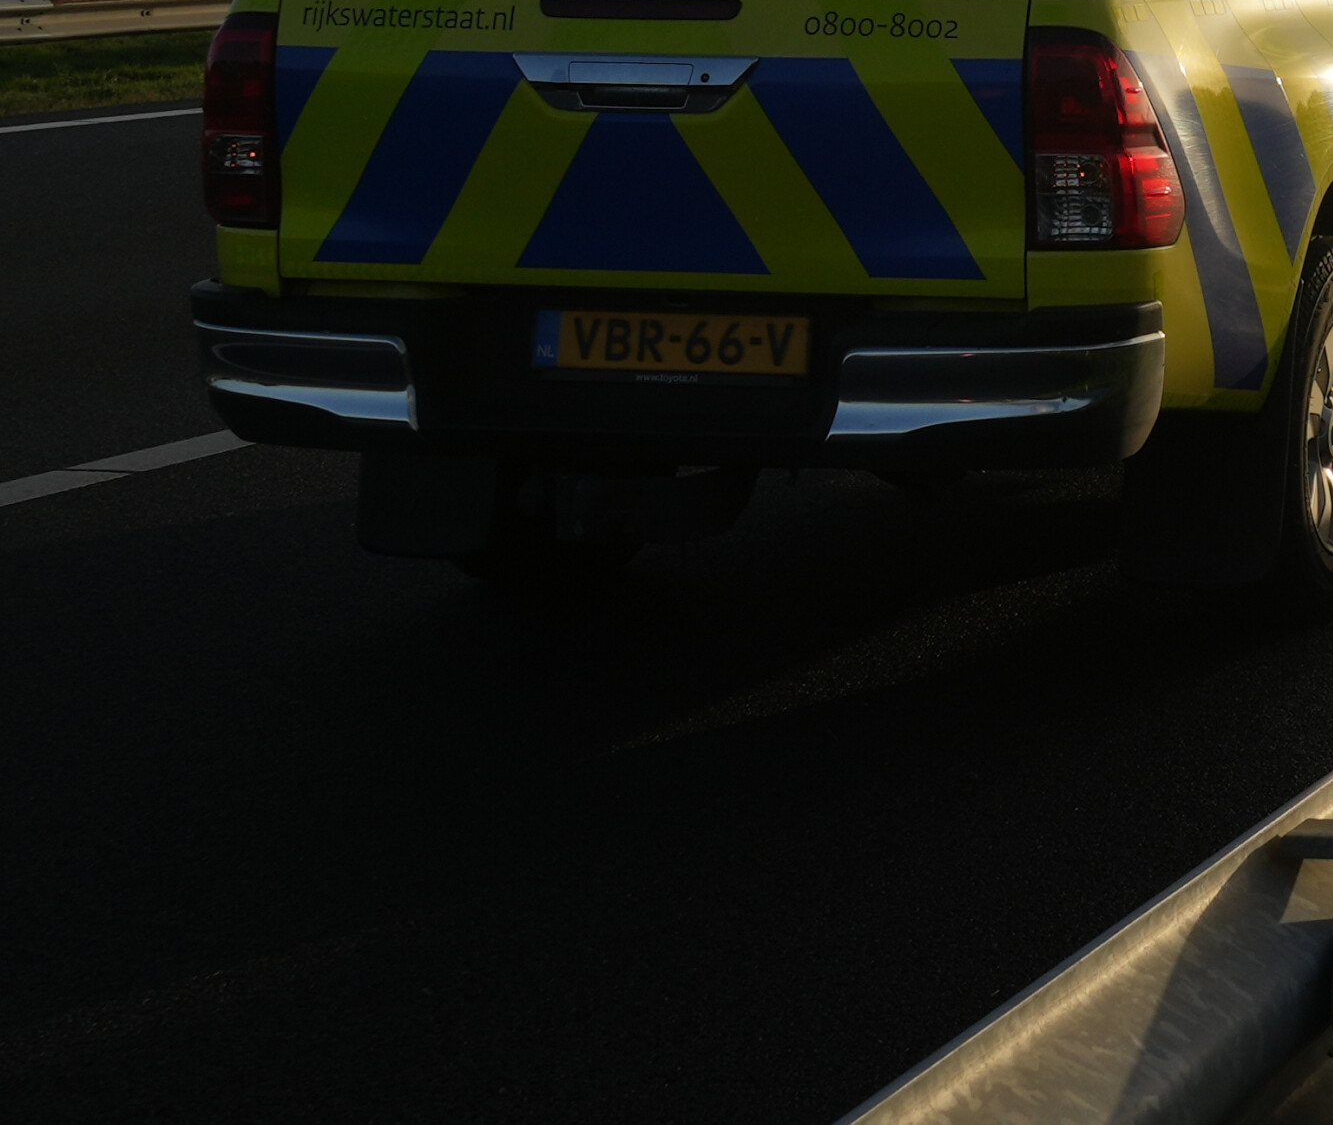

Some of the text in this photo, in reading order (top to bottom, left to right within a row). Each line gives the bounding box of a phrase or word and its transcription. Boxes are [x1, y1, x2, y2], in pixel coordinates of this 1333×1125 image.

[302, 0, 516, 32] rijkswaterstaat.nl
[804, 11, 959, 39] 0800-8002
[536, 317, 795, 366] NL VBR-66-V
[635, 373, 699, 383] www.toyota.nl
